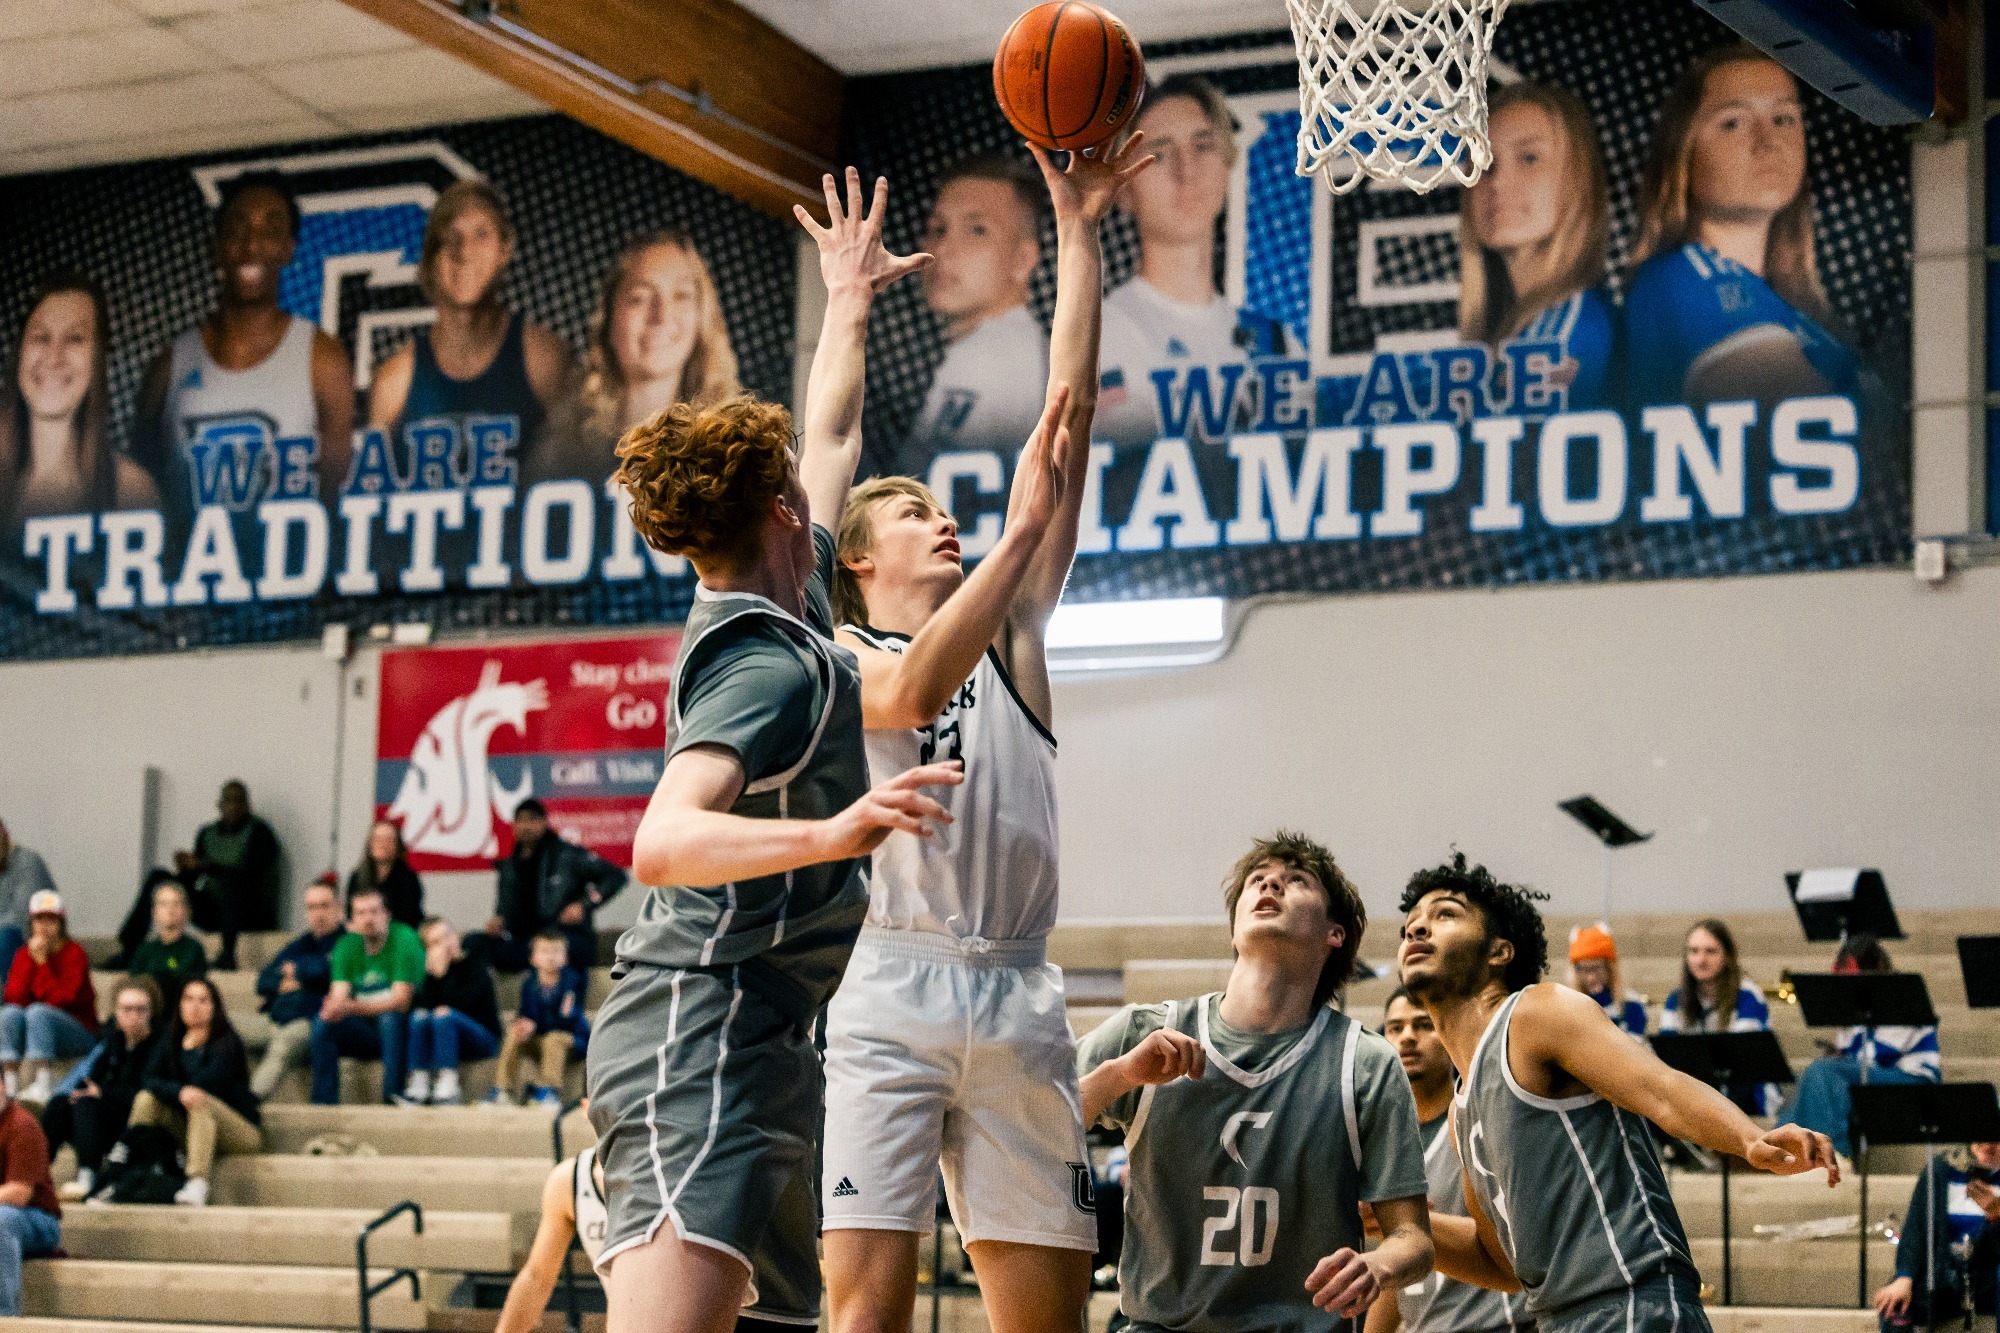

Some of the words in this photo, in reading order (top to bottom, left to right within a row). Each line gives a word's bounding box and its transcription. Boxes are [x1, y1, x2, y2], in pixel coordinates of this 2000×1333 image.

[1147, 358, 1312, 442] WE
[1346, 340, 1566, 428] ARE
[189, 433, 319, 508] WE
[340, 416, 519, 498] ARE
[605, 692, 658, 730] Go
[1200, 1186, 1280, 1267] 20
